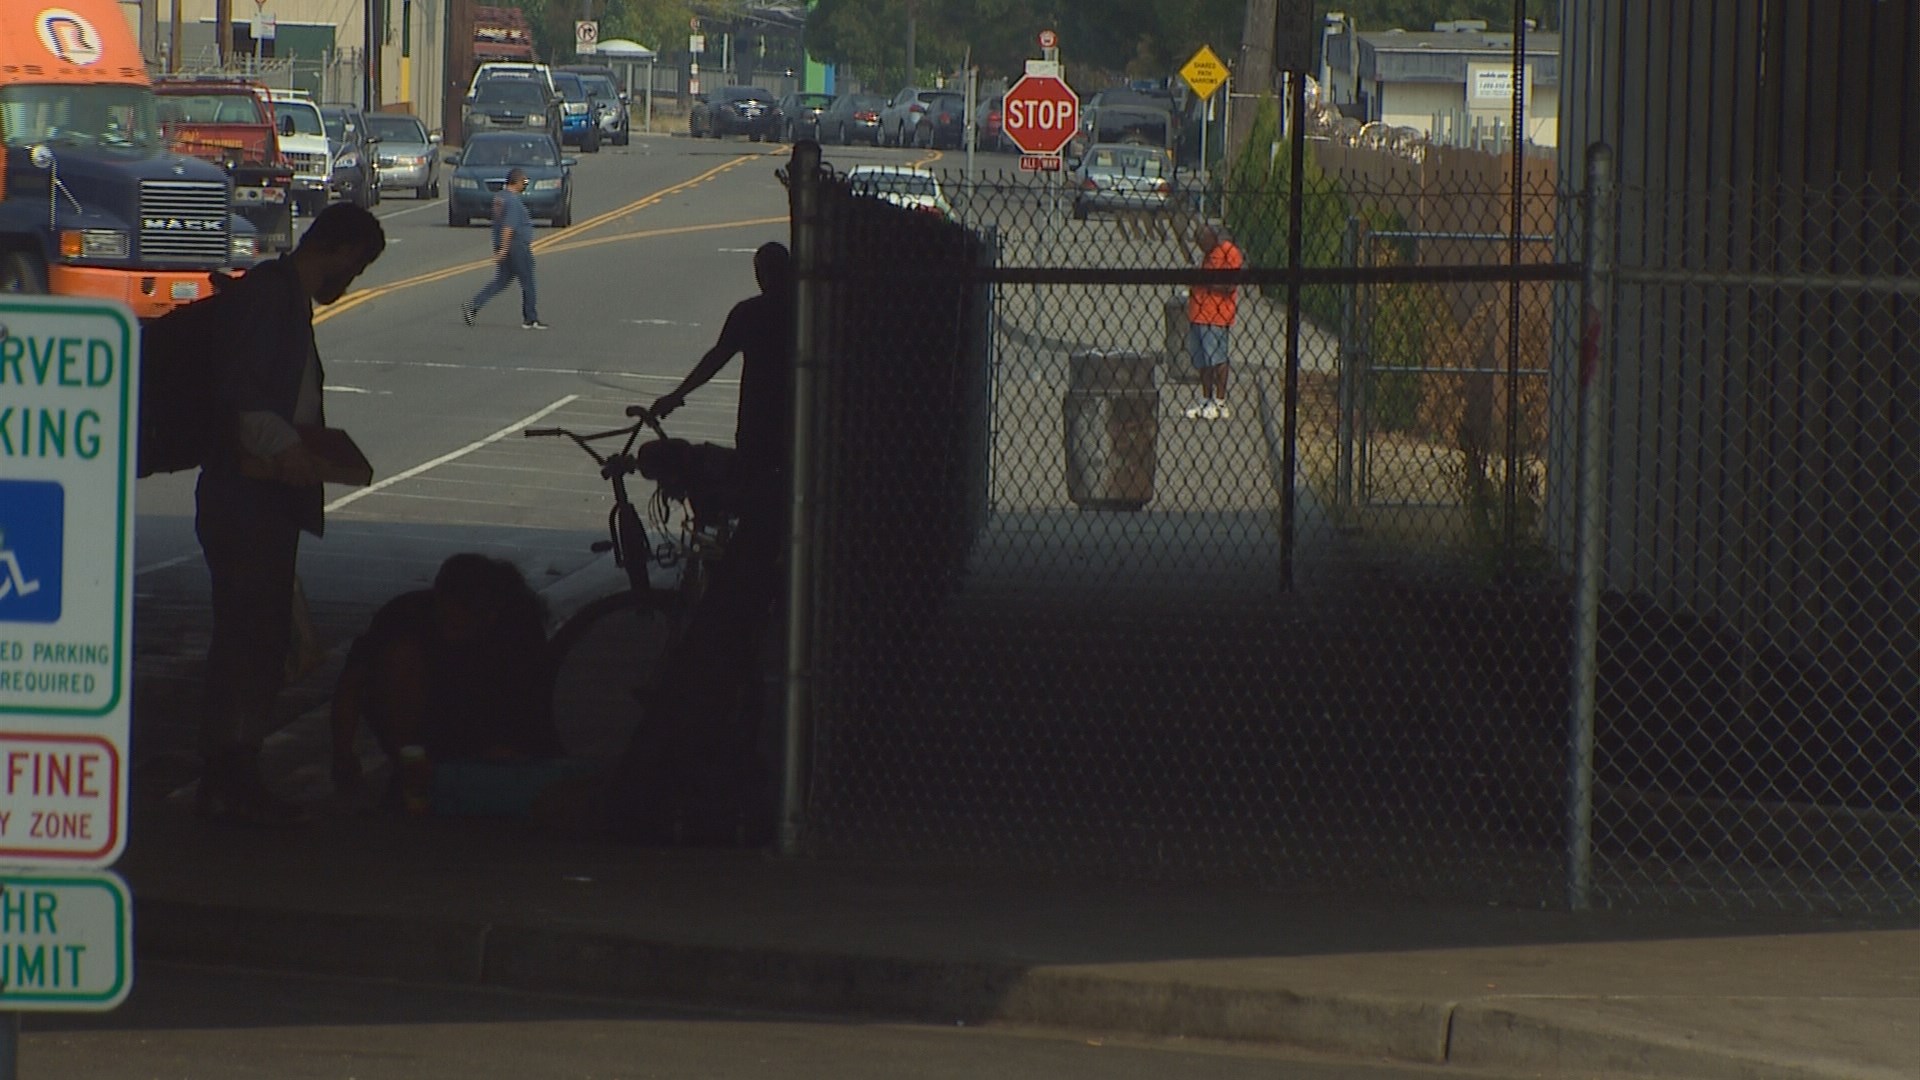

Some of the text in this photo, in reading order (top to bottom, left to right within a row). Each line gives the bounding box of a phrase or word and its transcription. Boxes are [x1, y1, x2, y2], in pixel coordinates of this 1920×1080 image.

[1008, 99, 1073, 130] STOP
[1022, 157, 1058, 169] ALL WAY
[143, 218, 223, 231] MACK
[0, 335, 114, 388] RVED
[33, 641, 109, 666] PARKING
[0, 671, 96, 694] REQUIRED
[7, 751, 100, 798] FINE
[30, 812, 92, 840] ZONE
[3, 890, 58, 935] HR
